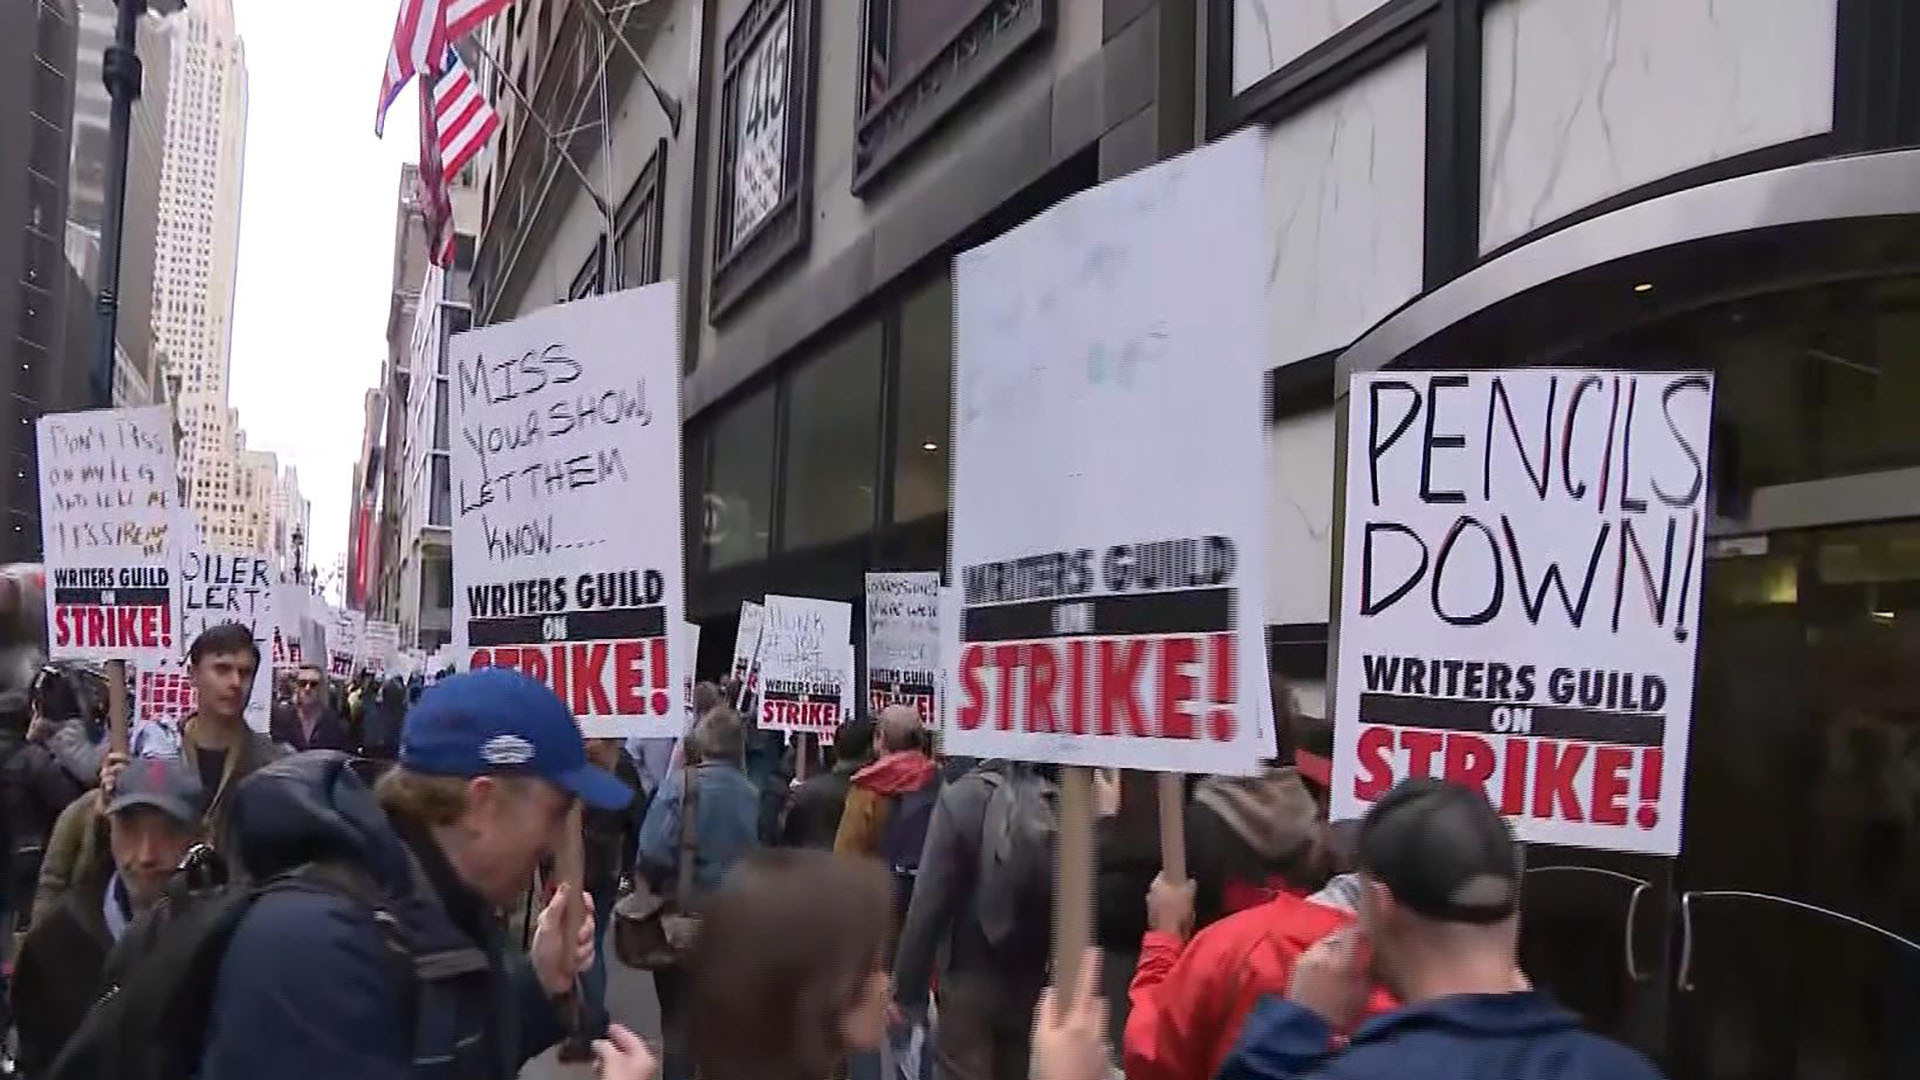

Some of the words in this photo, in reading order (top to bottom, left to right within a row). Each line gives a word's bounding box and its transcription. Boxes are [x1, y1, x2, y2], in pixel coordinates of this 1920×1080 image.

[458, 344, 583, 416] MISS
[548, 376, 652, 437] SHOW,
[1369, 376, 1711, 514] PENCILS
[460, 471, 516, 518] LET
[521, 447, 628, 497] THEM
[55, 568, 114, 588] WRITERS
[119, 567, 169, 587] GUILD
[468, 577, 567, 618] WRITERS
[575, 569, 665, 609] GUILD
[962, 549, 1096, 605] WRITERS
[1104, 535, 1237, 592] GUILD
[1361, 509, 1699, 642] DOWN!
[55, 604, 172, 648] STRIKE!
[542, 615, 568, 640] ON
[765, 678, 811, 693] WRITERS
[812, 681, 842, 695] GUILD
[957, 633, 1237, 742] STRIKE!
[1363, 654, 1537, 701] WRITERS
[1548, 667, 1667, 712] GUILD
[763, 700, 841, 726] STRIKE!
[1489, 705, 1534, 736] ON
